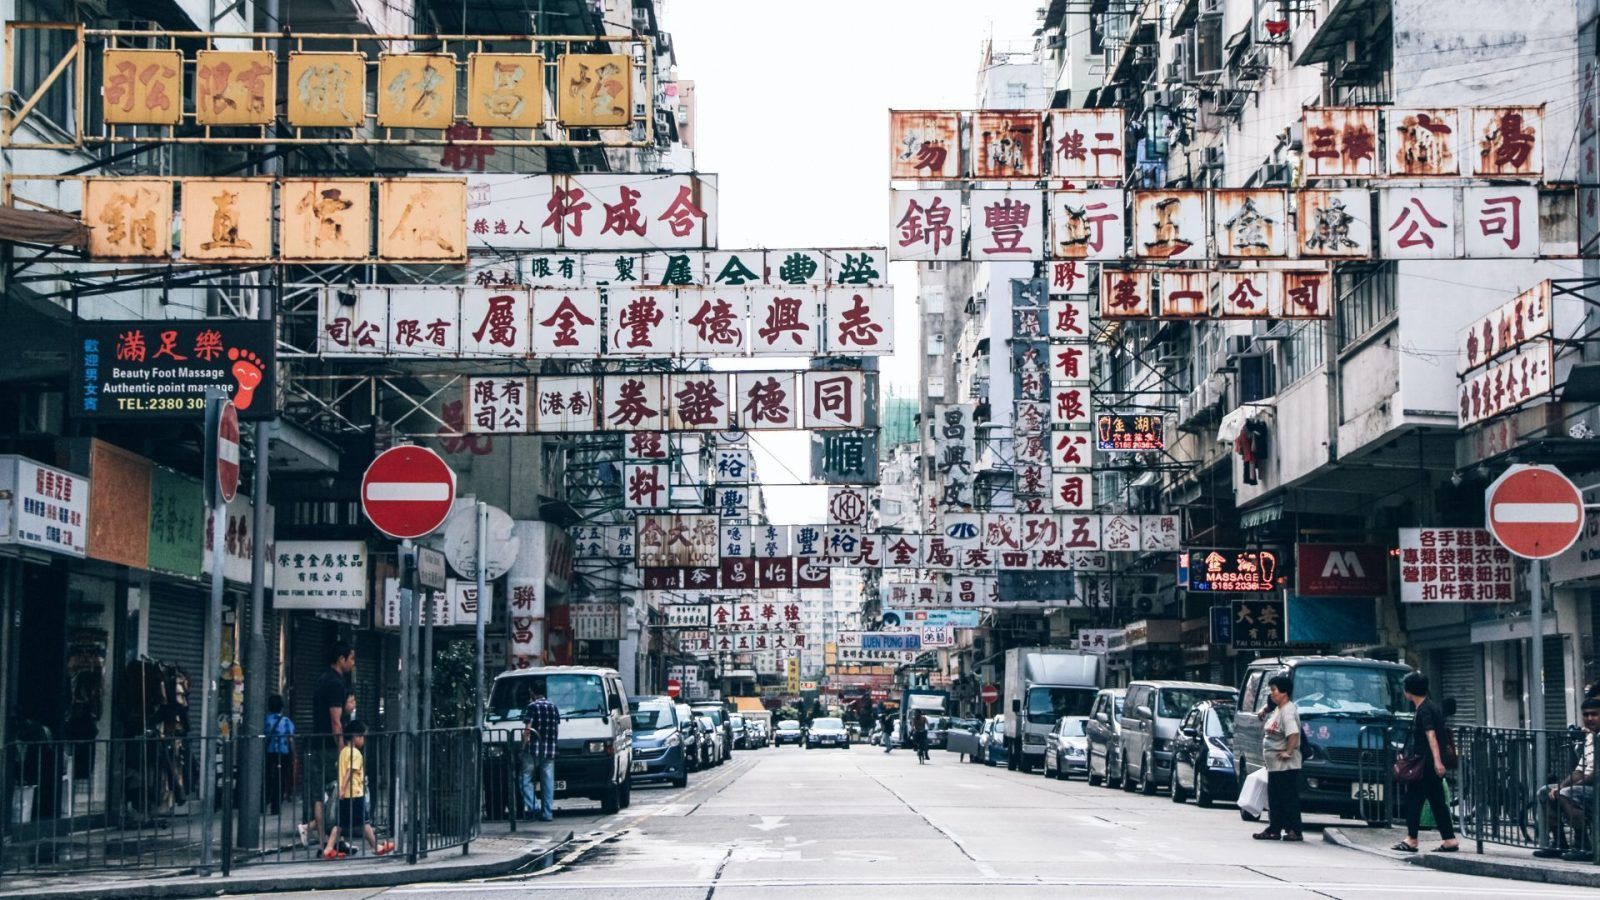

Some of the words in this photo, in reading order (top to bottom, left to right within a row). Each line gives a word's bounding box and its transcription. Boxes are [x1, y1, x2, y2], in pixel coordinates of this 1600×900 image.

[116, 329, 223, 362] 滿足樂
[113, 368, 150, 379] Beauty
[152, 368, 176, 378] Foot
[179, 368, 225, 379] Massage
[103, 383, 155, 393] Authentic
[157, 383, 185, 394] point
[1207, 573, 1259, 582] MASSAGE
